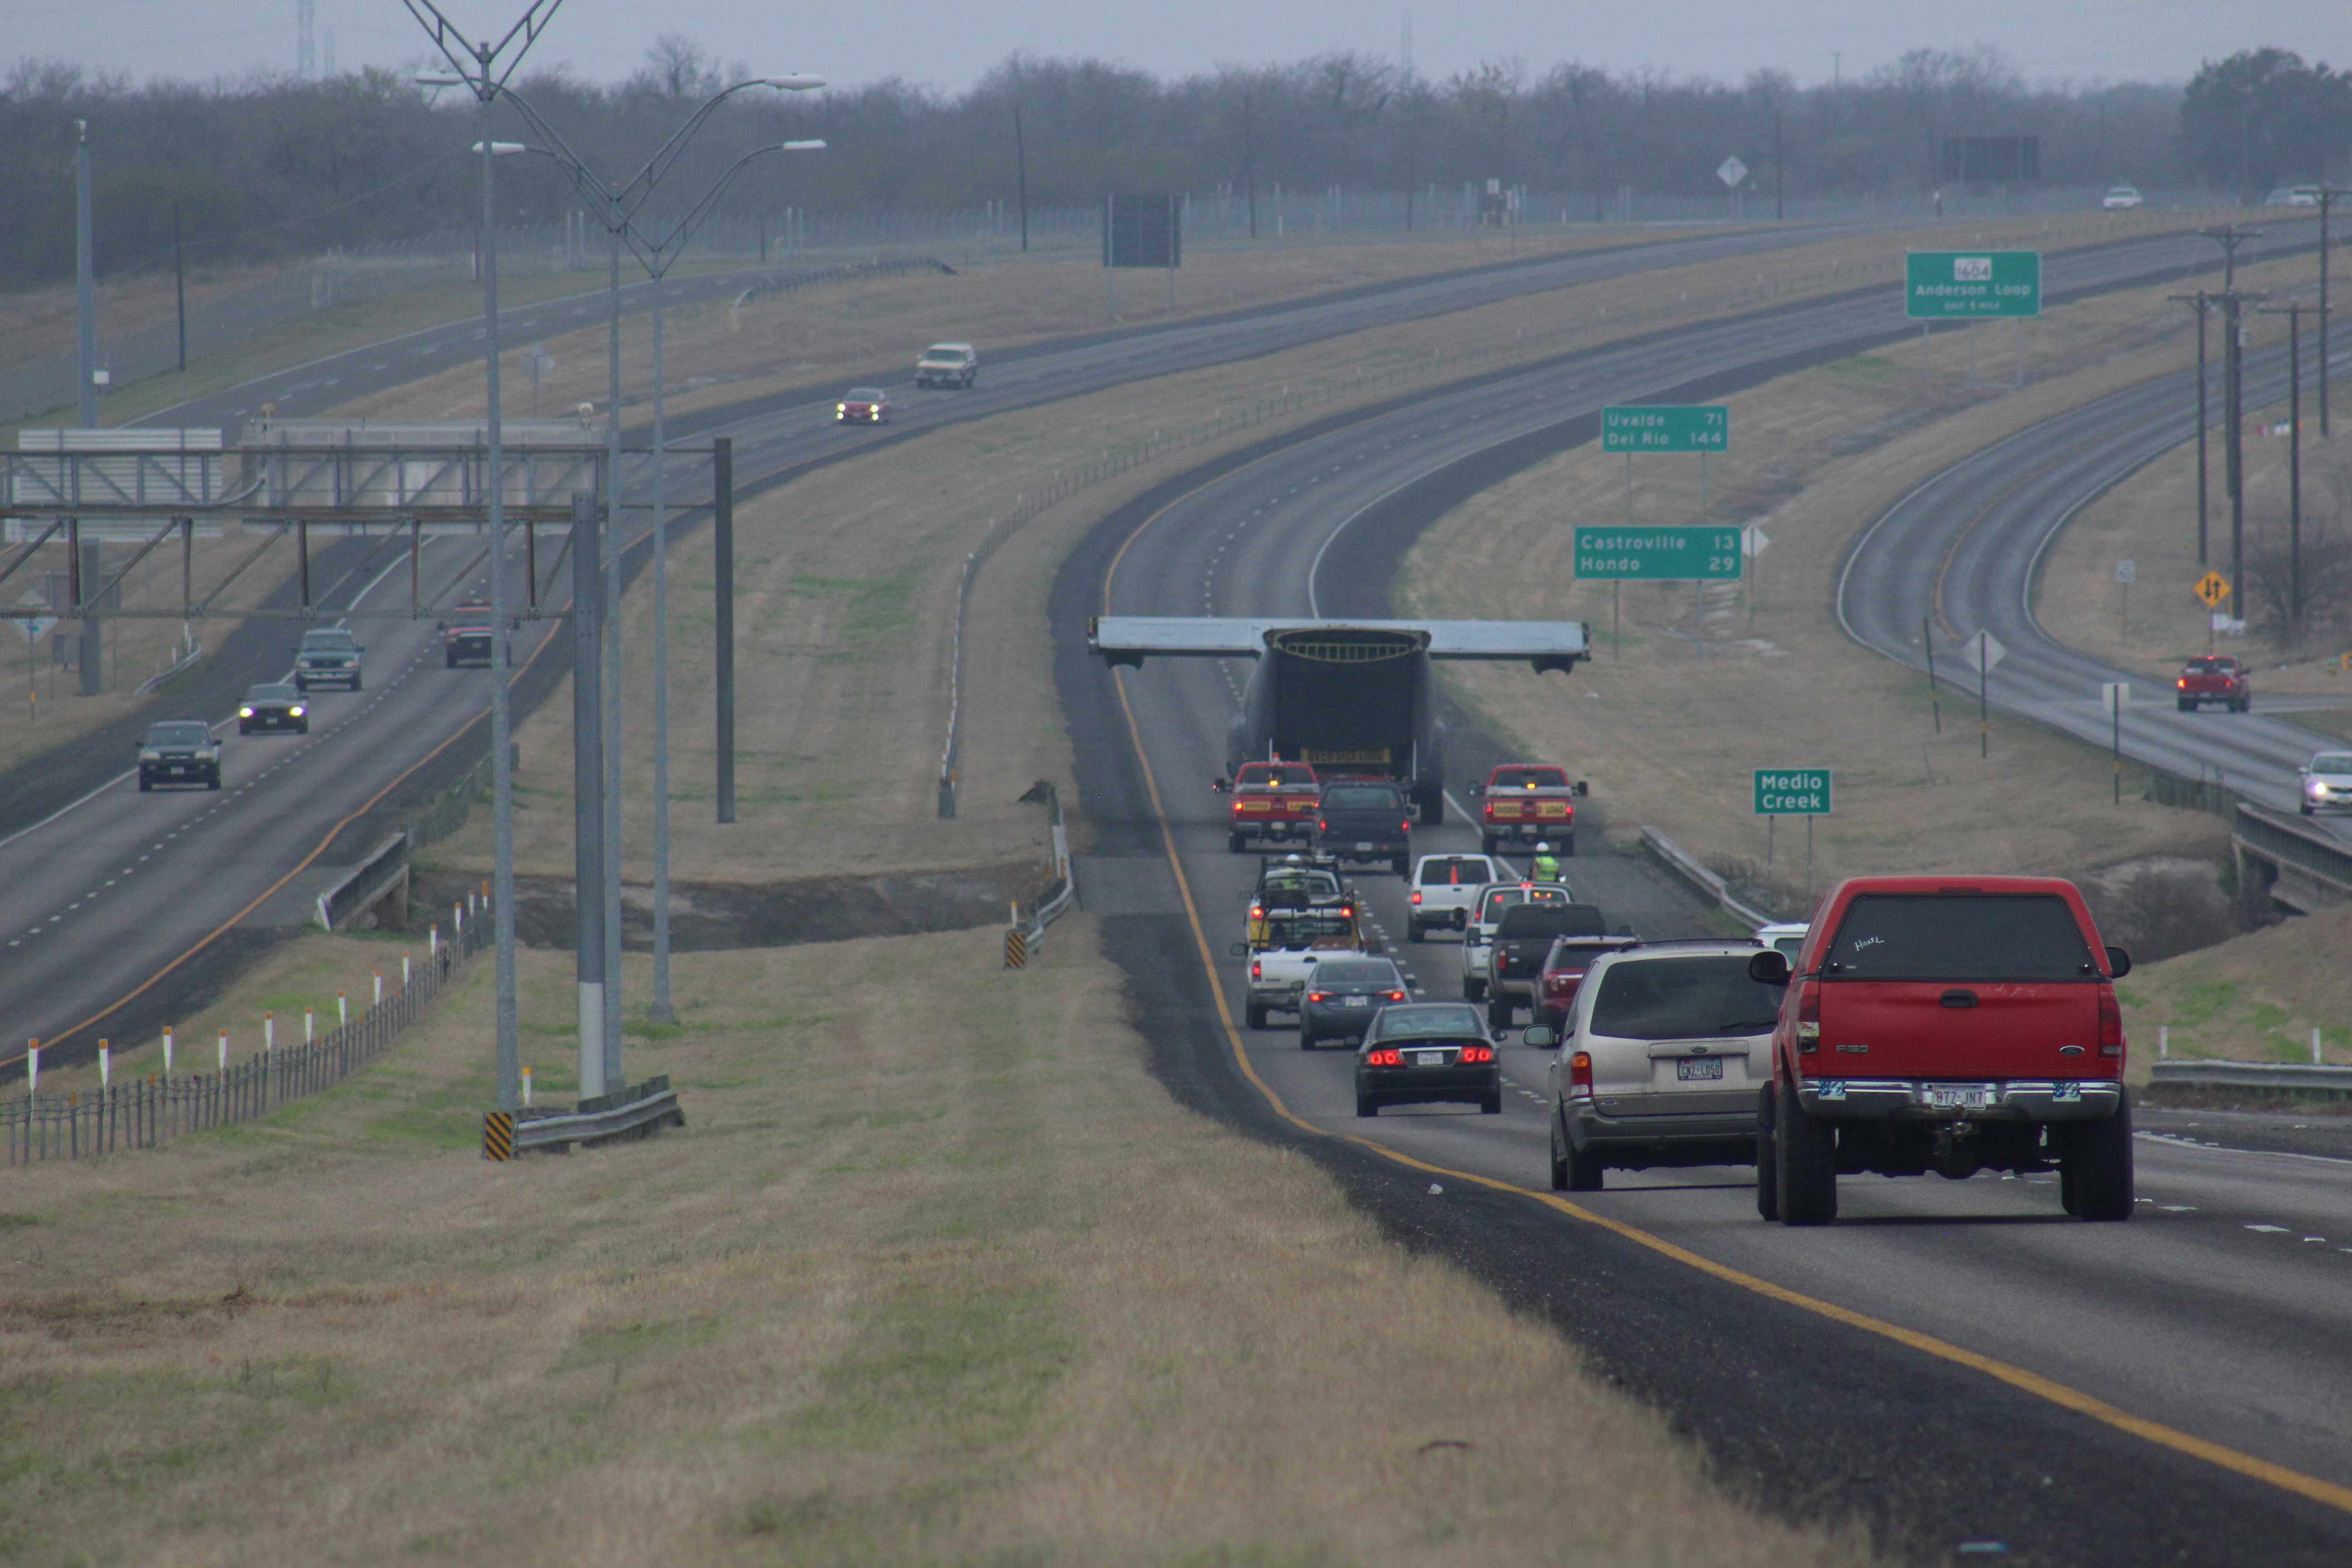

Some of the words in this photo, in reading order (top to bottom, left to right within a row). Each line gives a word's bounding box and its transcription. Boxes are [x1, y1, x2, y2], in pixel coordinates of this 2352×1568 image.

[1916, 285, 1987, 295] Anderson
[1995, 285, 2031, 298] Loop
[1970, 301, 1975, 311] 1
[1608, 415, 1664, 426] Uvalde
[1705, 413, 1722, 426] 71
[1608, 433, 1634, 445] Del
[1642, 432, 1669, 445] Rio
[1690, 432, 1721, 444] 144
[1581, 535, 1686, 549] Castroville
[1715, 536, 1734, 549] 13
[1581, 557, 1640, 570] Hondo
[1709, 557, 1734, 570] 29
[1761, 773, 1823, 789] Medio
[1762, 793, 1821, 808] Creek
